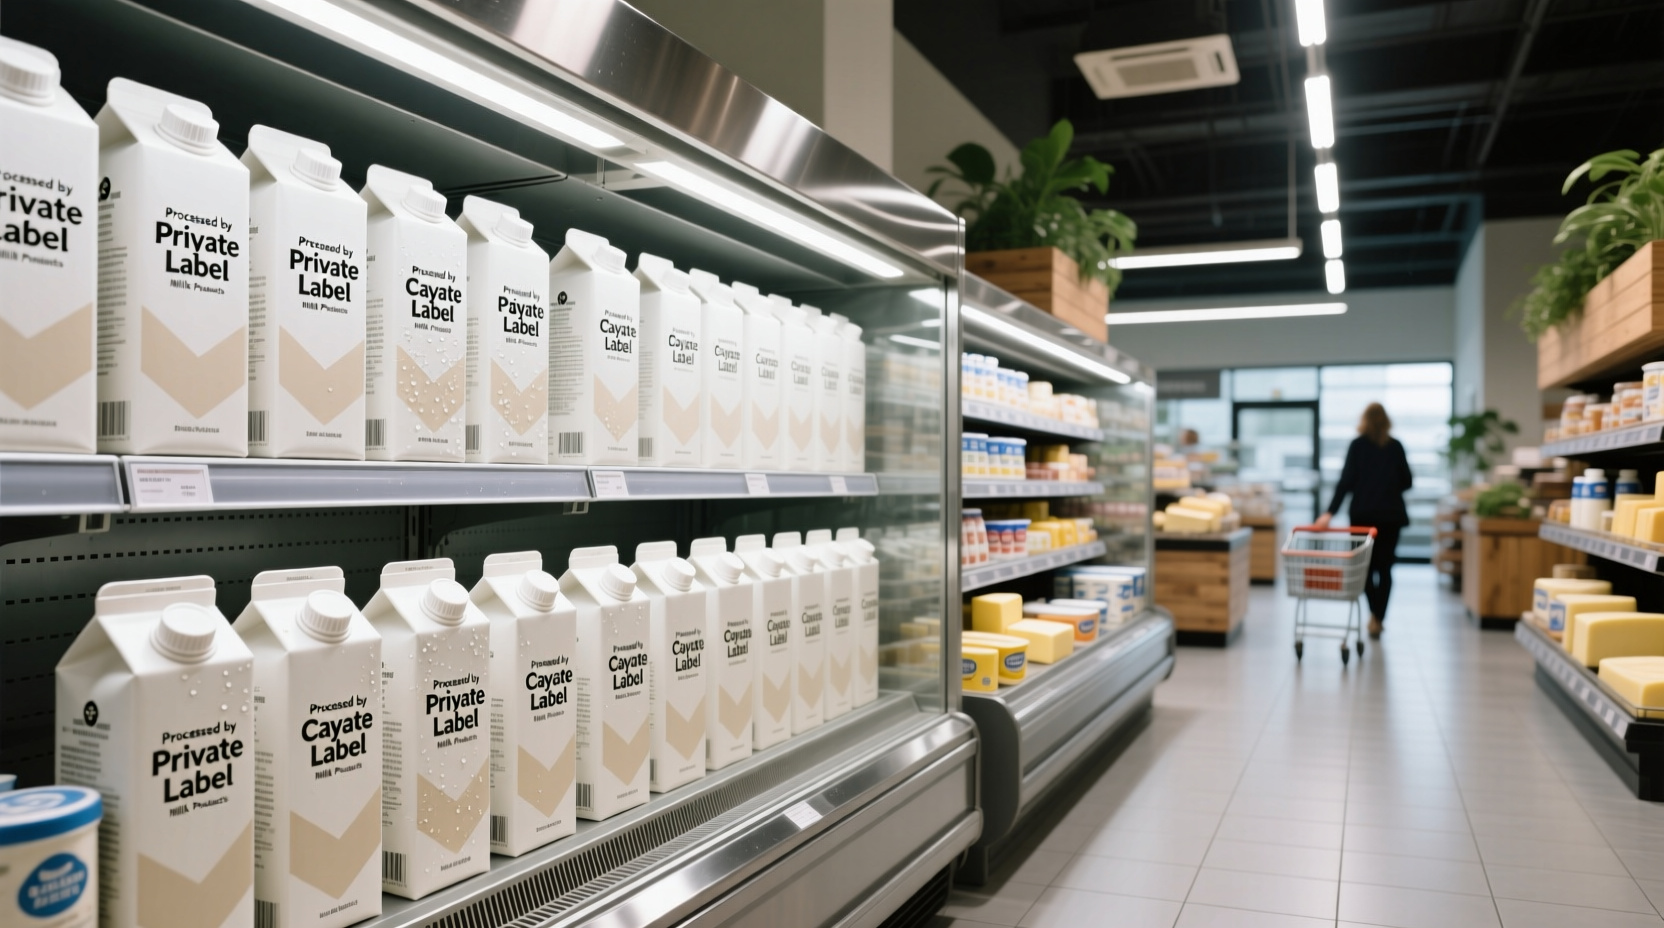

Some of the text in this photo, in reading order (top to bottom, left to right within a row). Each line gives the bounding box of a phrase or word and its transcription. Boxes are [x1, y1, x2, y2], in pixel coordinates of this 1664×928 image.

[58, 178, 73, 197] by
[0, 220, 68, 252] abel
[221, 216, 232, 232] by
[155, 221, 239, 258] Private
[342, 244, 354, 260] by
[165, 249, 230, 282] Label
[290, 248, 359, 280] Private
[298, 273, 351, 303] Label
[405, 277, 462, 304] Cayate
[411, 299, 454, 323] Label
[503, 315, 539, 337] Label
[605, 336, 632, 354] Label
[525, 669, 573, 692] Cayate
[613, 668, 643, 691] Label
[356, 694, 368, 708] by
[426, 688, 485, 715] Private
[530, 686, 567, 711] Label
[224, 720, 237, 735] by
[301, 711, 373, 742] Cayate
[433, 707, 479, 737] Label
[152, 738, 244, 777] Private
[311, 732, 367, 767] Label
[163, 763, 234, 803] Label
